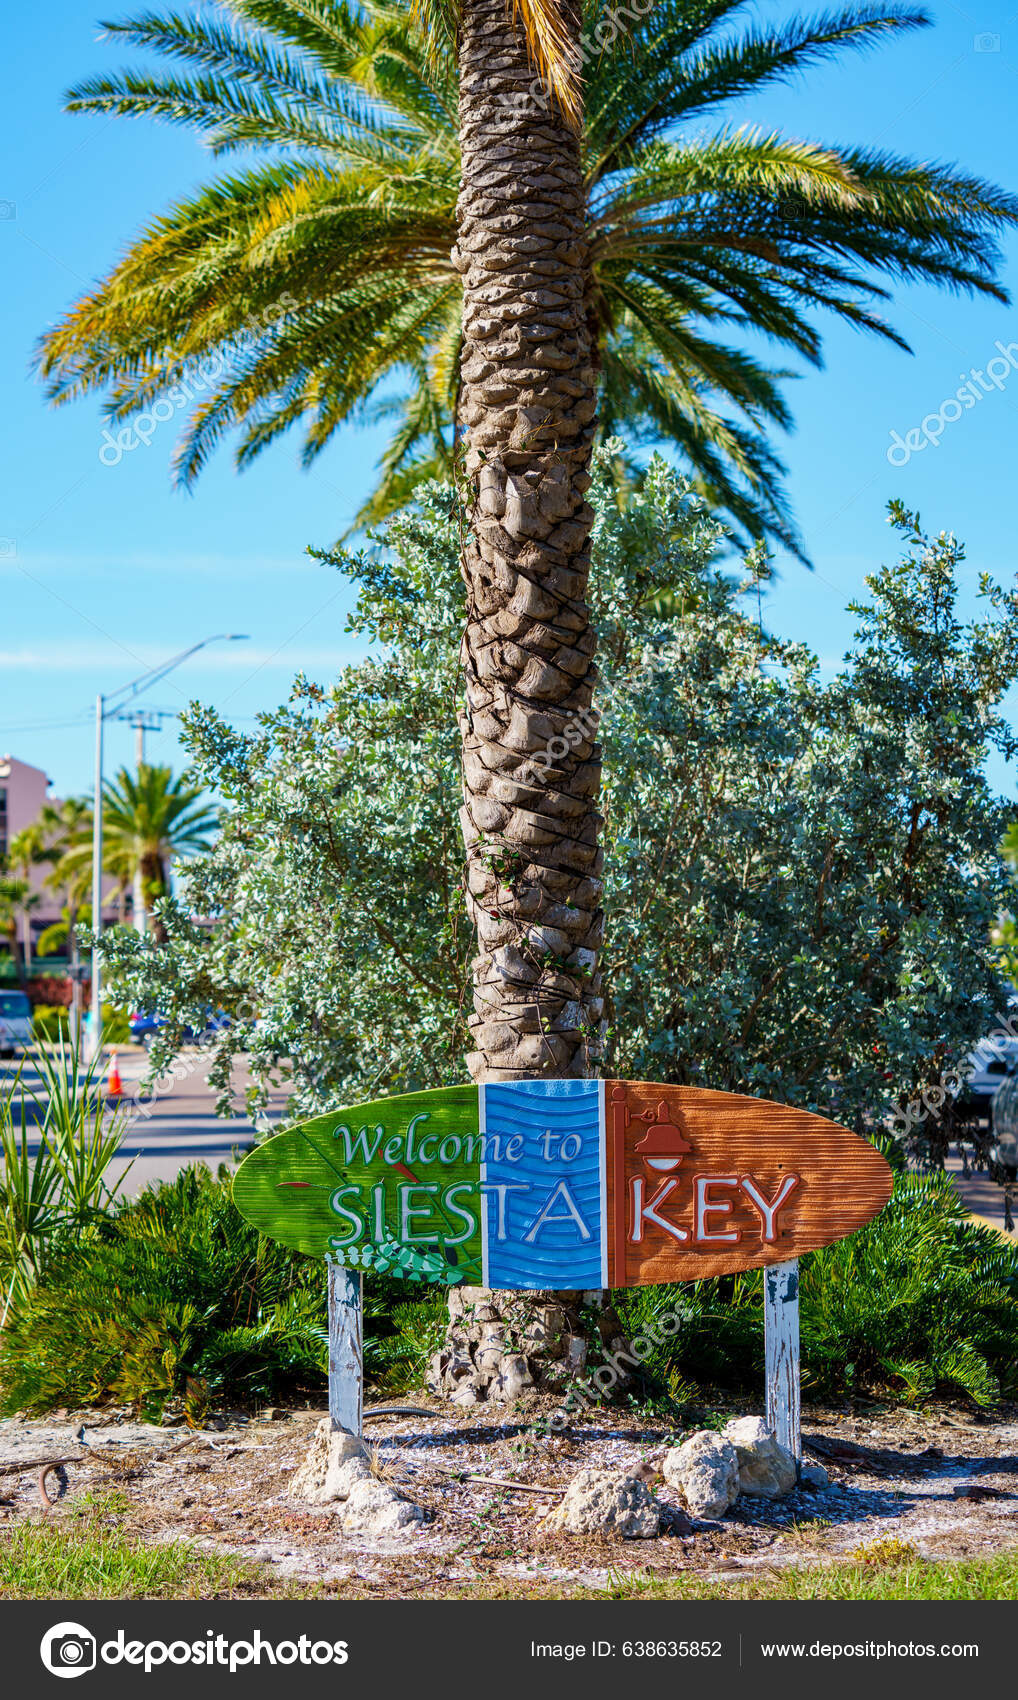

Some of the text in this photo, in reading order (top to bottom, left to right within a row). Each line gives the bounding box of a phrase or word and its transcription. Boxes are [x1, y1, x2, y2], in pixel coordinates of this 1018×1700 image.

[334, 1113, 583, 1166] Welcome to
[328, 1174, 799, 1248] SIESTA KEY
